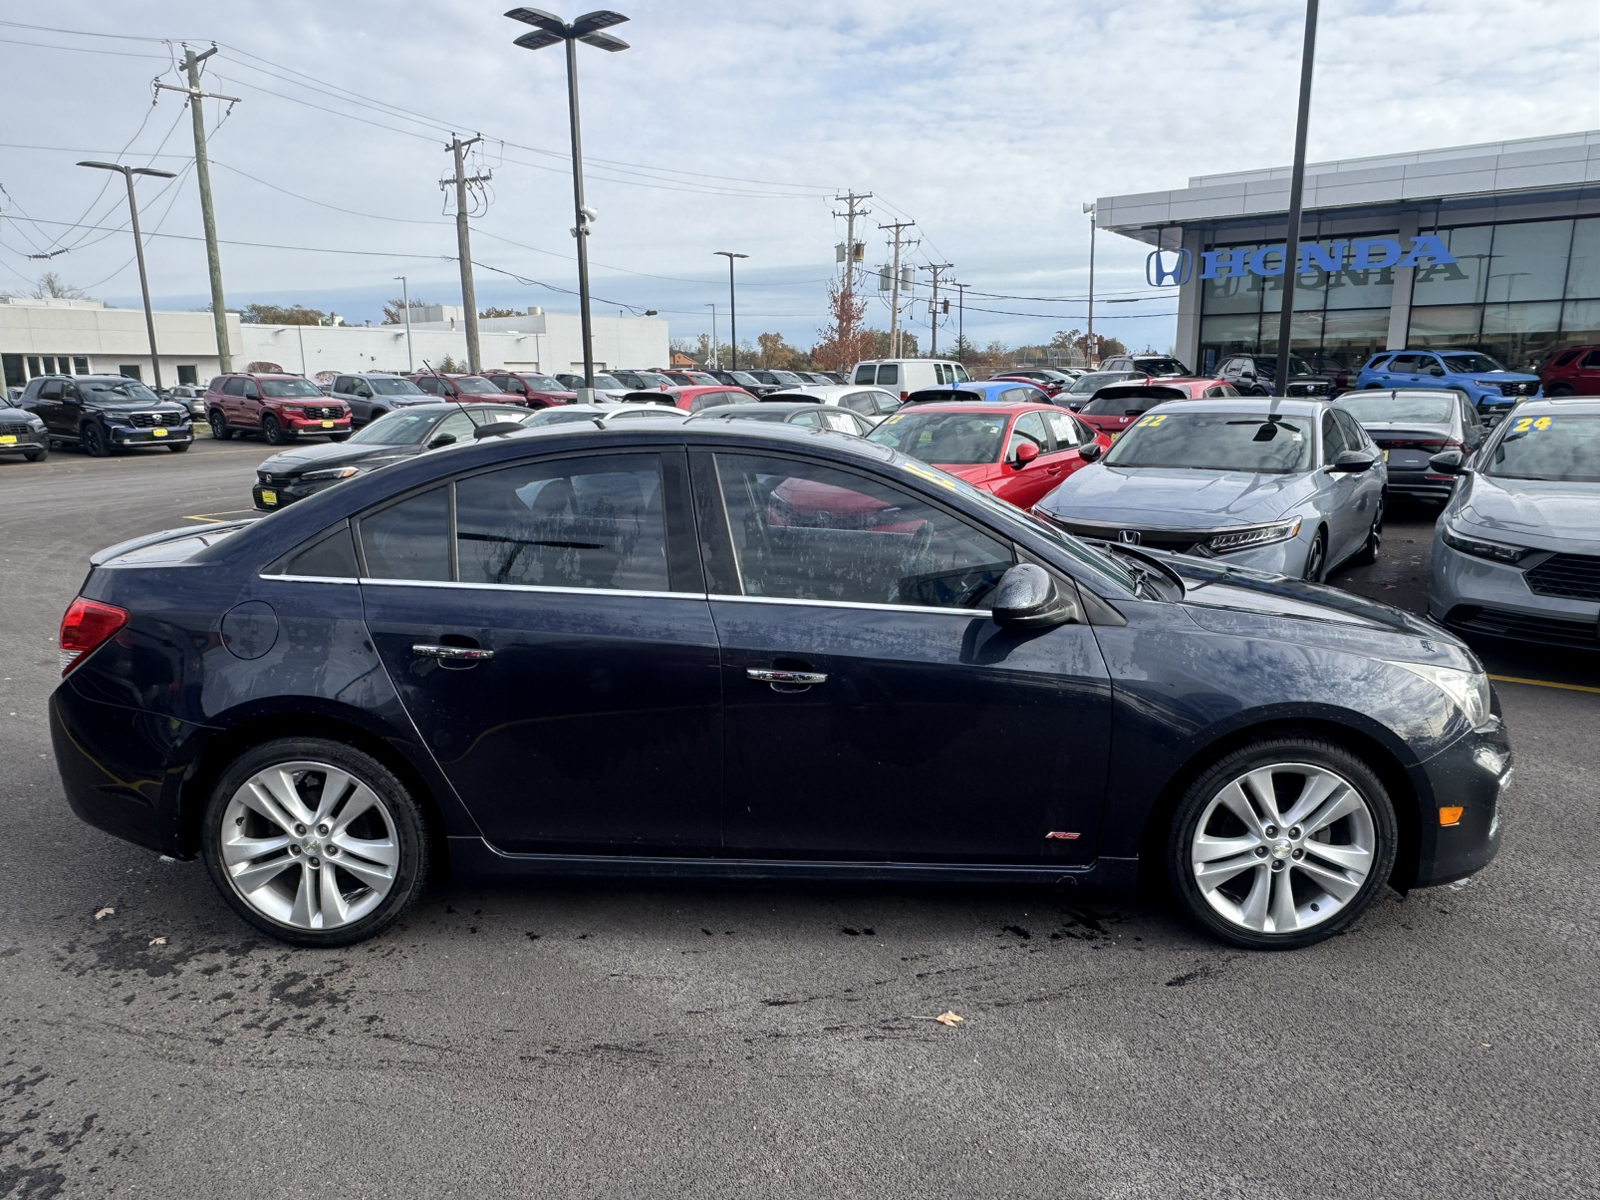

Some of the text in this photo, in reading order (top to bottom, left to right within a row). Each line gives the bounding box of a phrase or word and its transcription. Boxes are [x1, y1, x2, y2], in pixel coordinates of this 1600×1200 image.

[1199, 235, 1458, 278] HONDA
[1137, 414, 1168, 428] 22
[1512, 417, 1552, 432] 24
